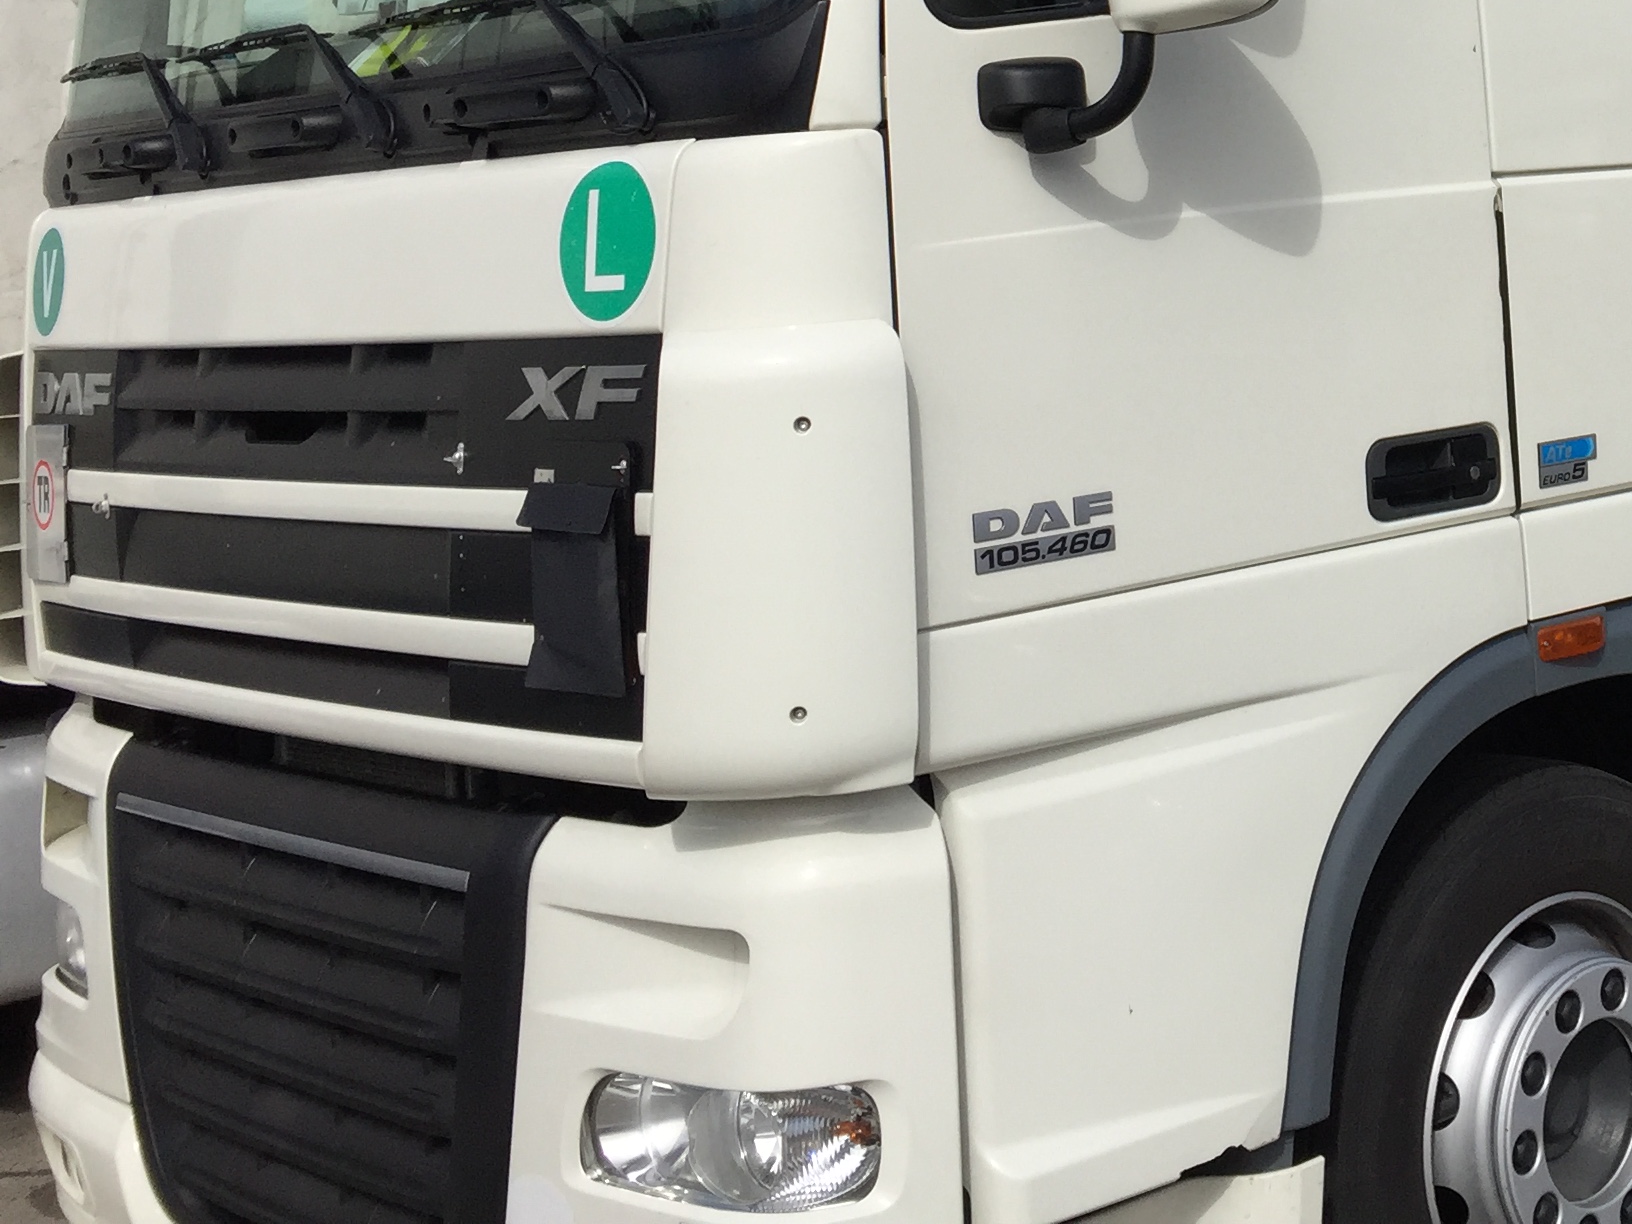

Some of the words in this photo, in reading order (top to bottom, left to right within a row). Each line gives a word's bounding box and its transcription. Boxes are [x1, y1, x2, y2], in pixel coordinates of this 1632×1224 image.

[584, 188, 626, 293] L
[42, 248, 59, 318] V
[36, 371, 113, 416] DAF
[505, 363, 648, 421] XF
[36, 475, 50, 514] TR
[972, 490, 1114, 544] DAF
[979, 527, 1113, 570] 105.460
